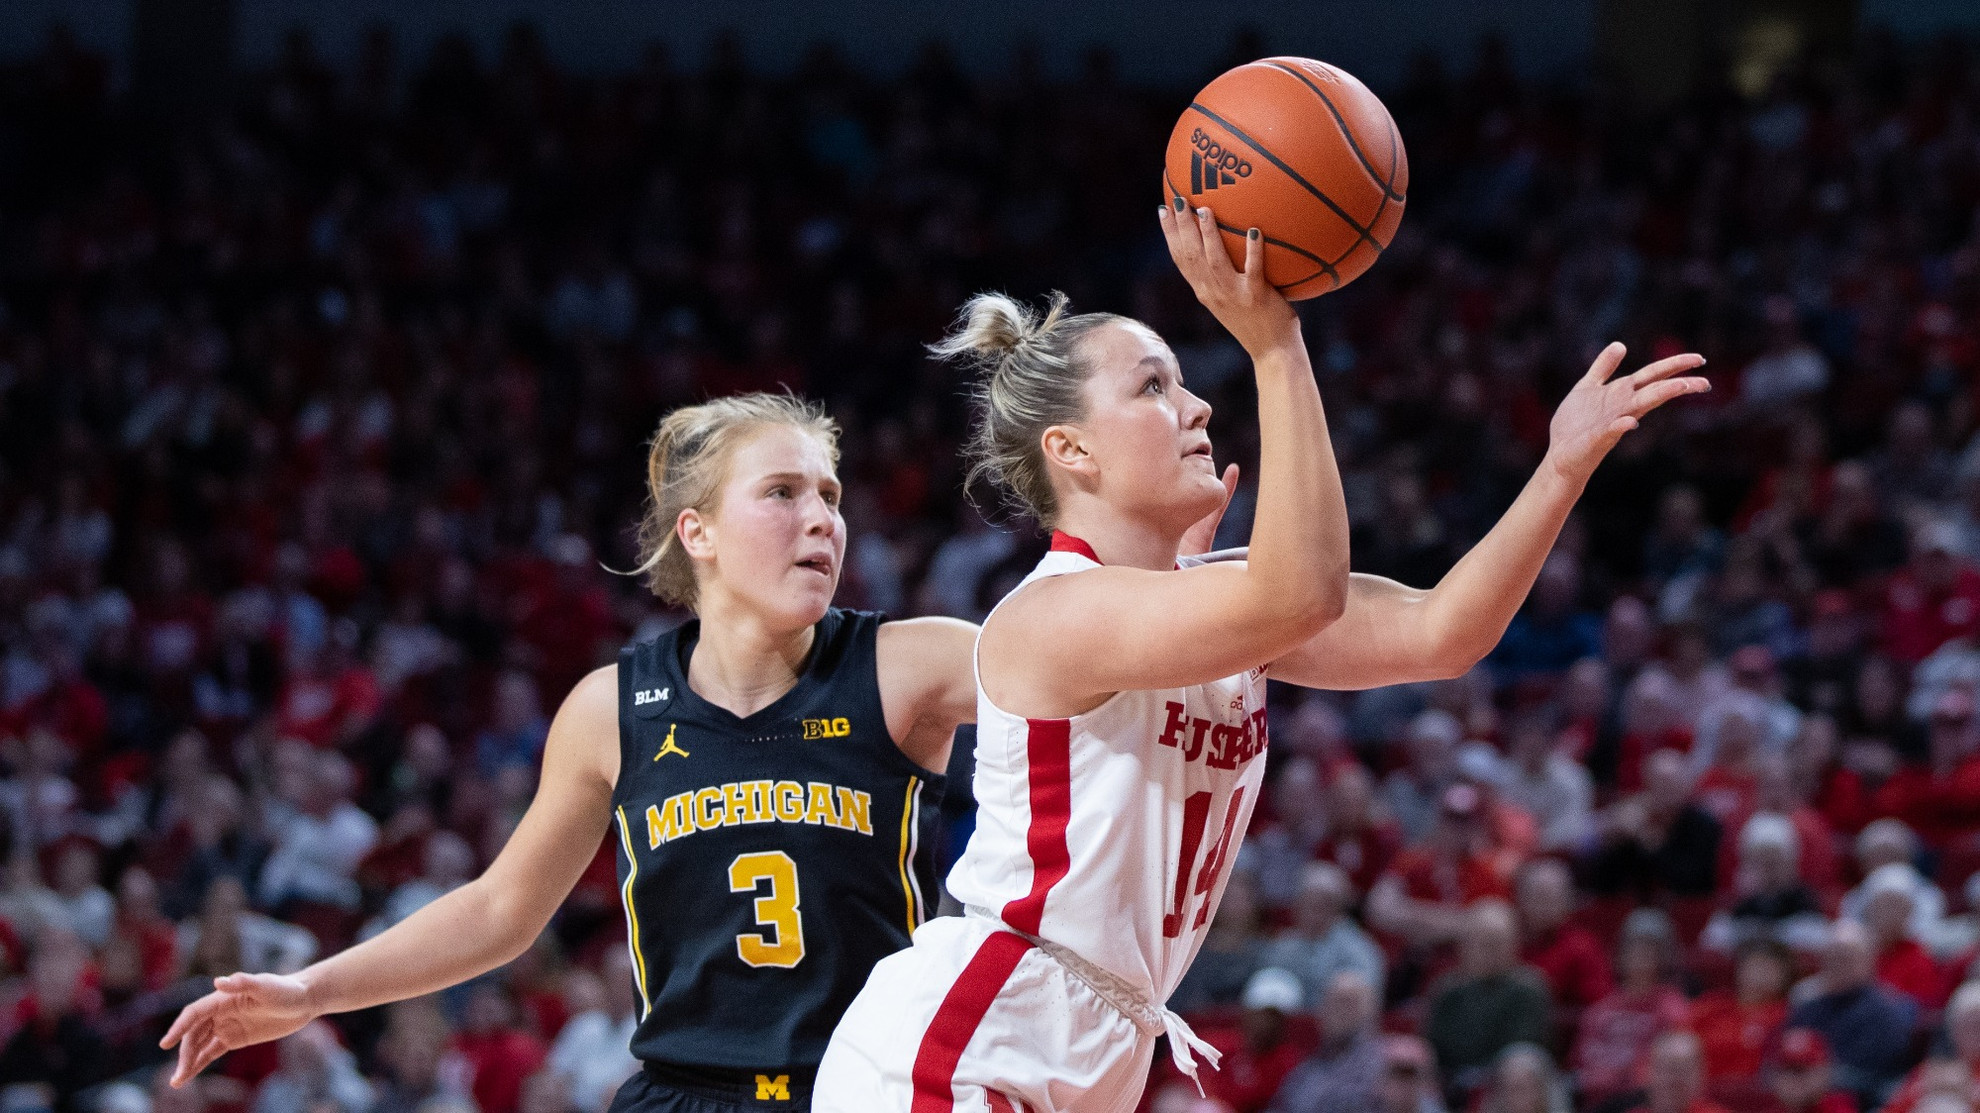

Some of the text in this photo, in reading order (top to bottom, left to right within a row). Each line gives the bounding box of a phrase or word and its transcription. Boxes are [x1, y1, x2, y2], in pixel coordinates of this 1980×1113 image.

[1191, 127, 1252, 178] adidas
[635, 687, 669, 705] BLM
[646, 779, 873, 850] MICHIGAN
[1162, 785, 1245, 938] 14
[728, 850, 805, 969] 3
[755, 1074, 790, 1100] M
